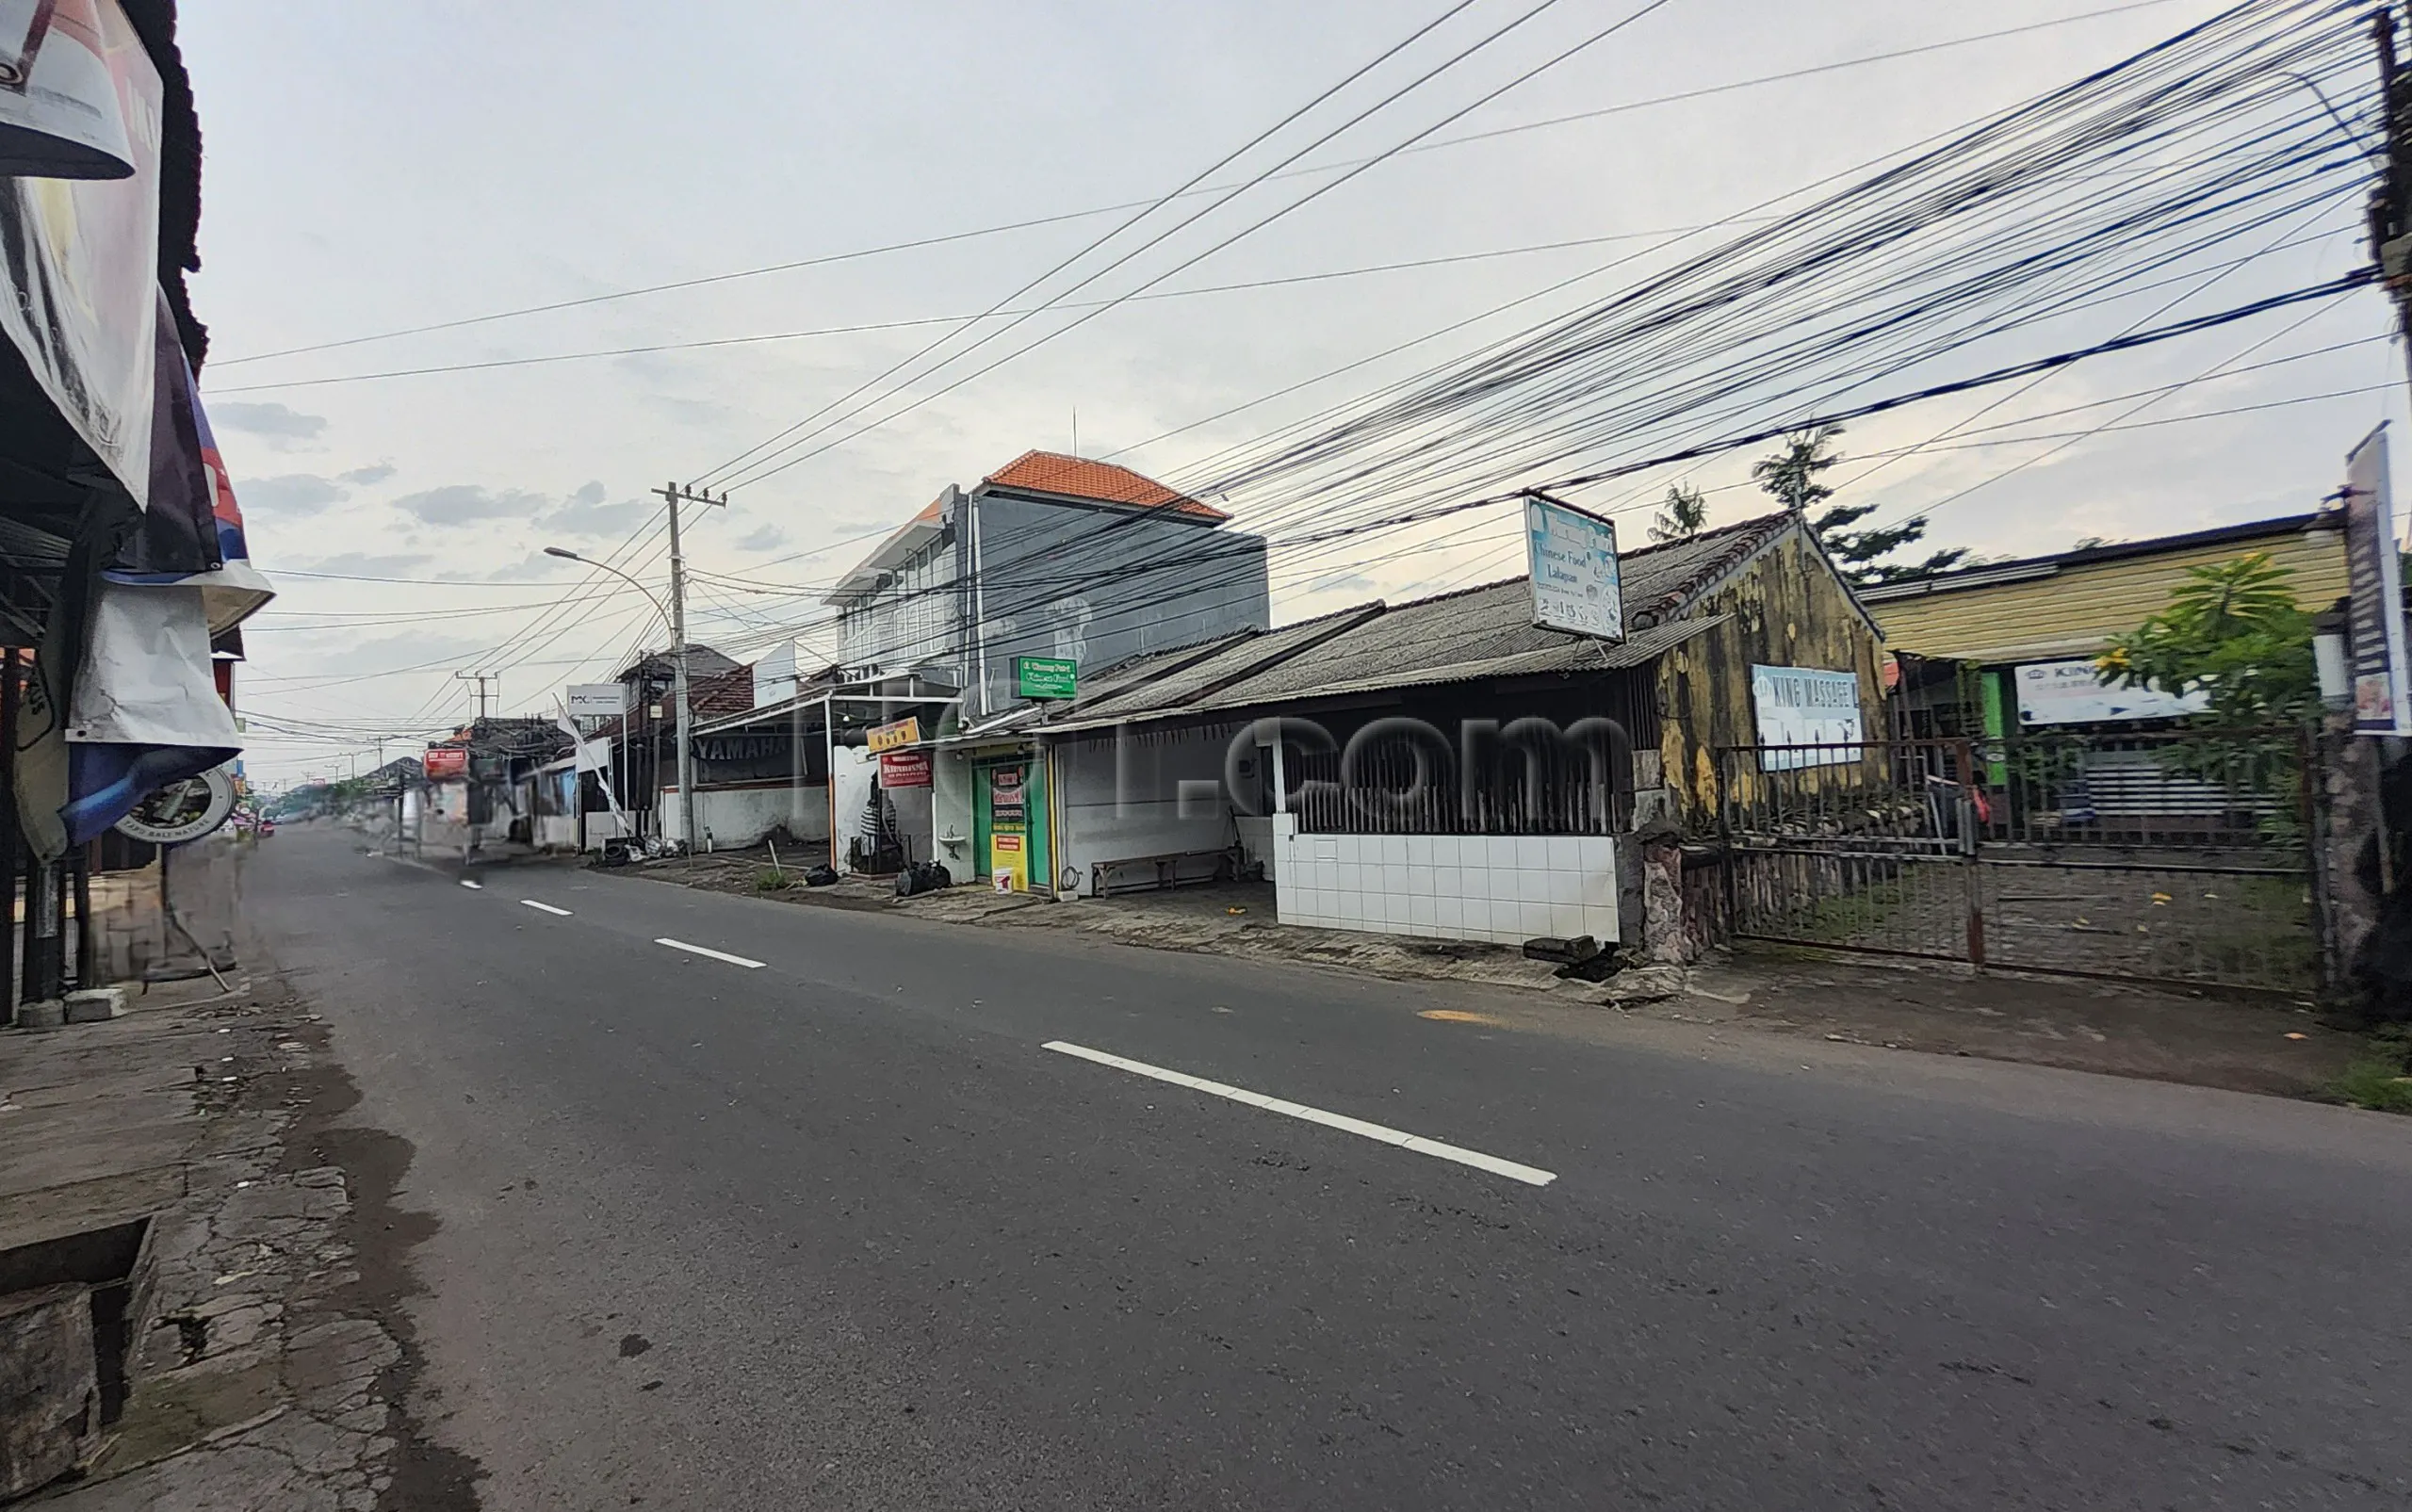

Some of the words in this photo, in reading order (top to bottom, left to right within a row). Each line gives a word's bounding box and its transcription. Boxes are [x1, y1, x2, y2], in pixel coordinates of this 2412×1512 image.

[1534, 541, 1567, 562] Chinese
[1567, 550, 1588, 568] Food
[1772, 676, 1801, 707] KING
[1803, 677, 1850, 708] MASSAGE
[694, 736, 787, 760] YAMAHA
